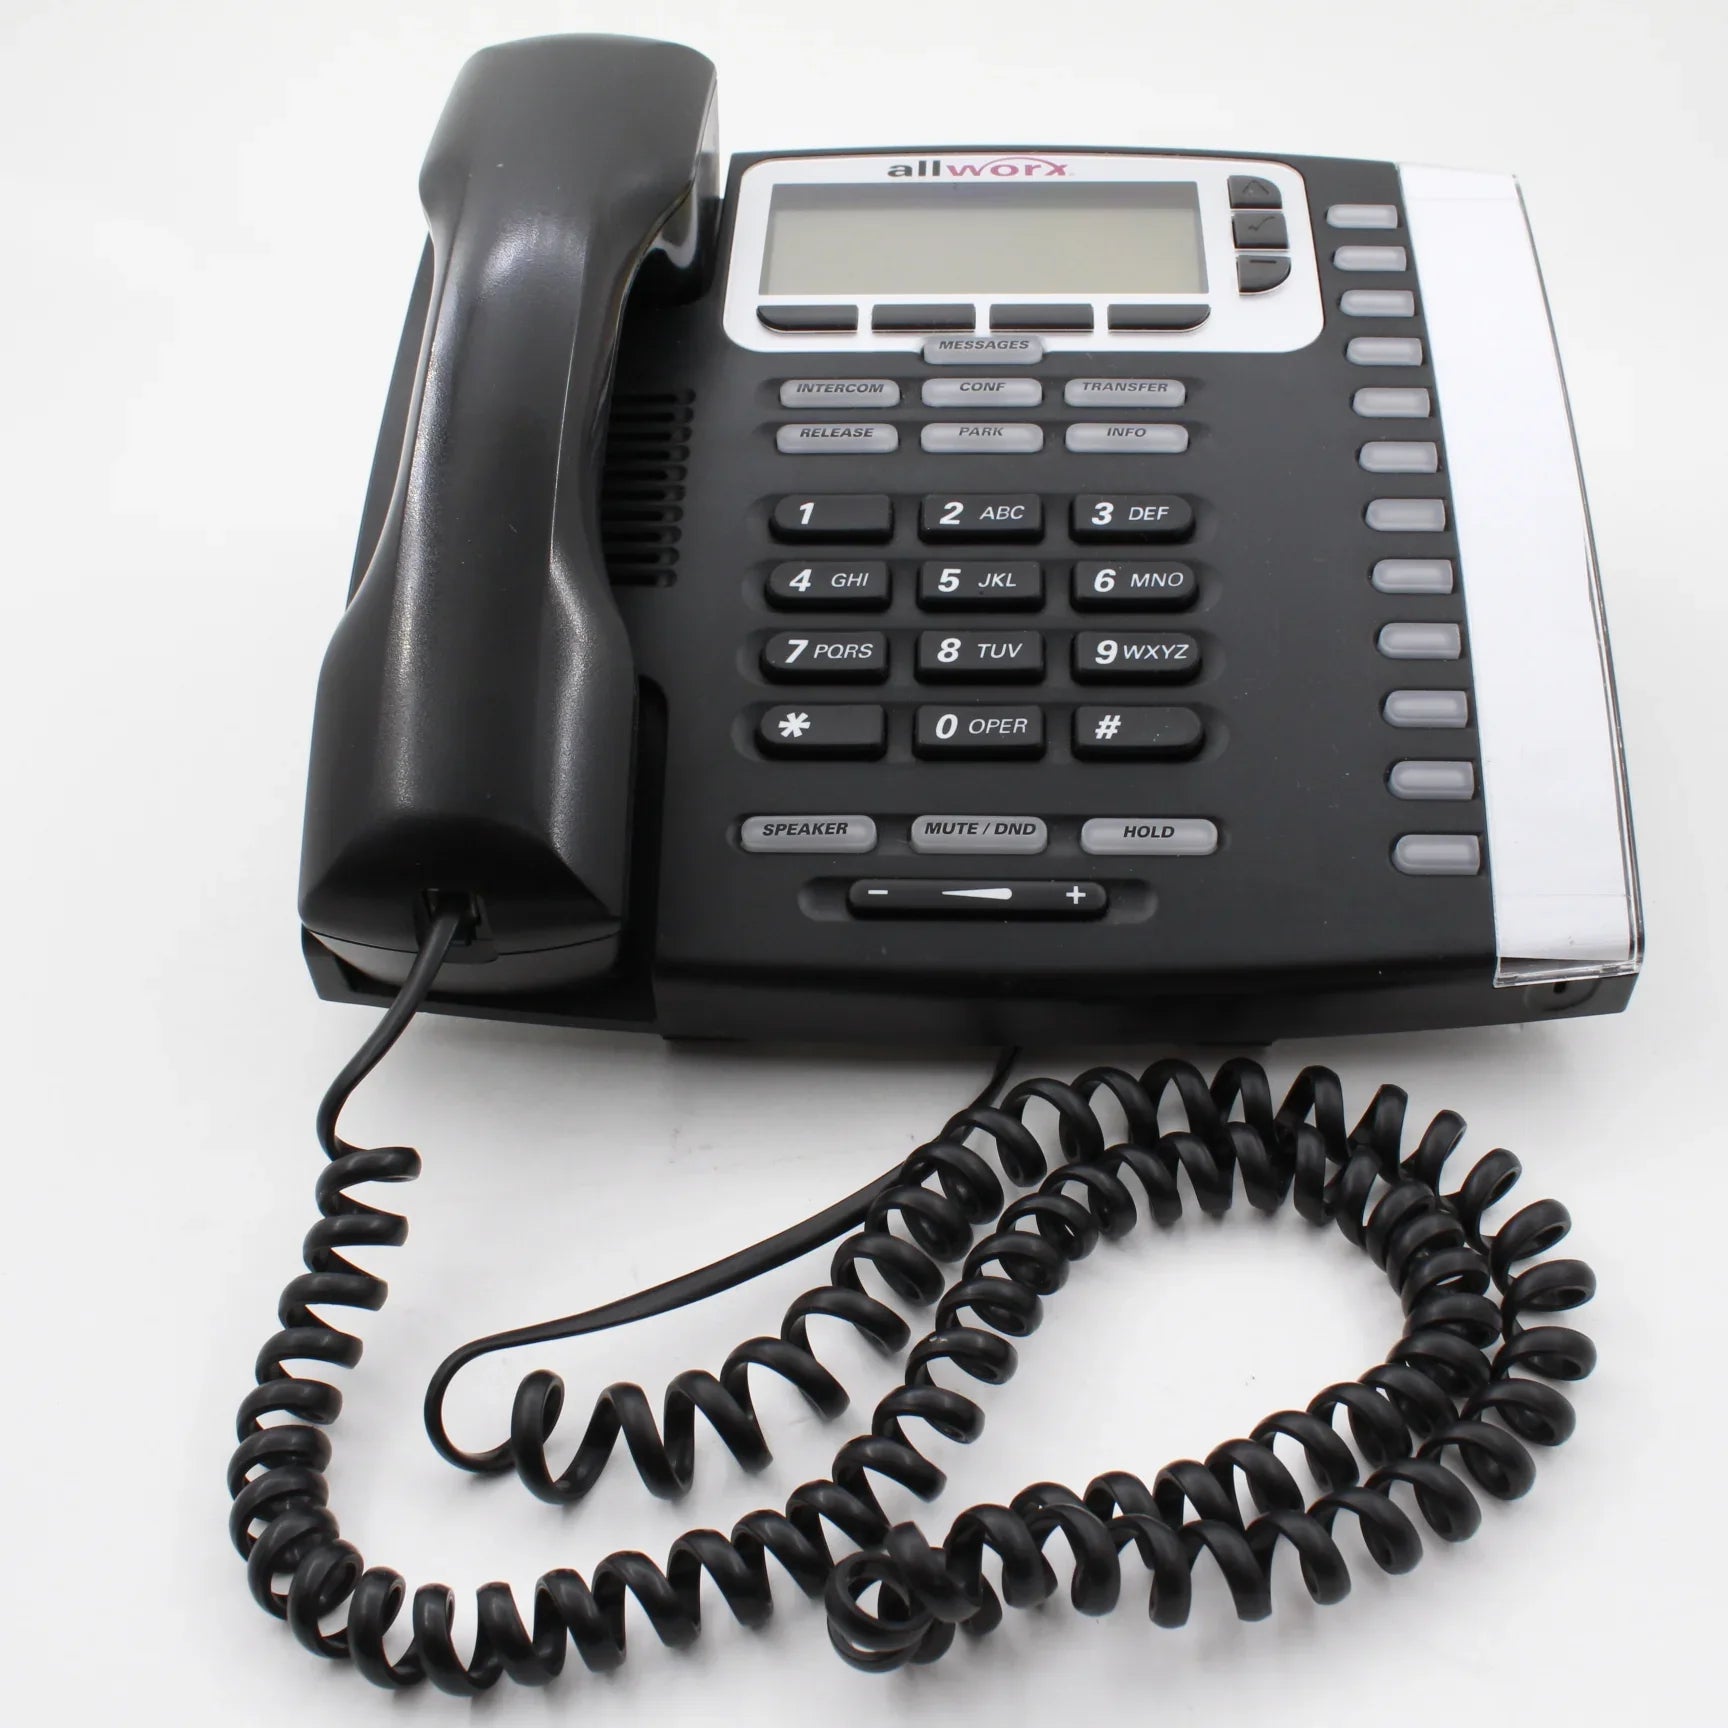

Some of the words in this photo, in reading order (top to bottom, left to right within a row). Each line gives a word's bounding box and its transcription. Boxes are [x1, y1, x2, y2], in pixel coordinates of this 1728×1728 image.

[887, 157, 1069, 178] allworx
[938, 339, 1030, 350] MESSAGES
[796, 383, 885, 393] INTERCOM
[959, 381, 1006, 392] CONF
[1082, 381, 1169, 392] TRANSFER
[799, 427, 874, 438] RELEASE
[958, 426, 1004, 437] PARK
[1106, 427, 1147, 438] INFO
[799, 502, 815, 525] 1
[939, 501, 964, 525] 2
[979, 505, 1025, 520] ABC
[1091, 501, 1115, 526] 3
[1128, 506, 1170, 521] DEF
[788, 568, 812, 592] 4
[831, 572, 869, 588] GHI
[937, 568, 962, 593] 5
[978, 572, 1017, 588] JKL
[1093, 568, 1117, 593] 6
[1130, 572, 1184, 588] MNO
[785, 639, 809, 664] 7
[813, 643, 874, 659] PQRS
[936, 637, 962, 663] 8
[977, 643, 1023, 659] TUV
[1095, 639, 1118, 665] 9
[1123, 643, 1190, 660] WXYZ
[935, 713, 959, 740] 0
[968, 718, 1028, 735] OPER
[762, 822, 849, 837] SPEAKER
[1123, 825, 1175, 839] HOLD
